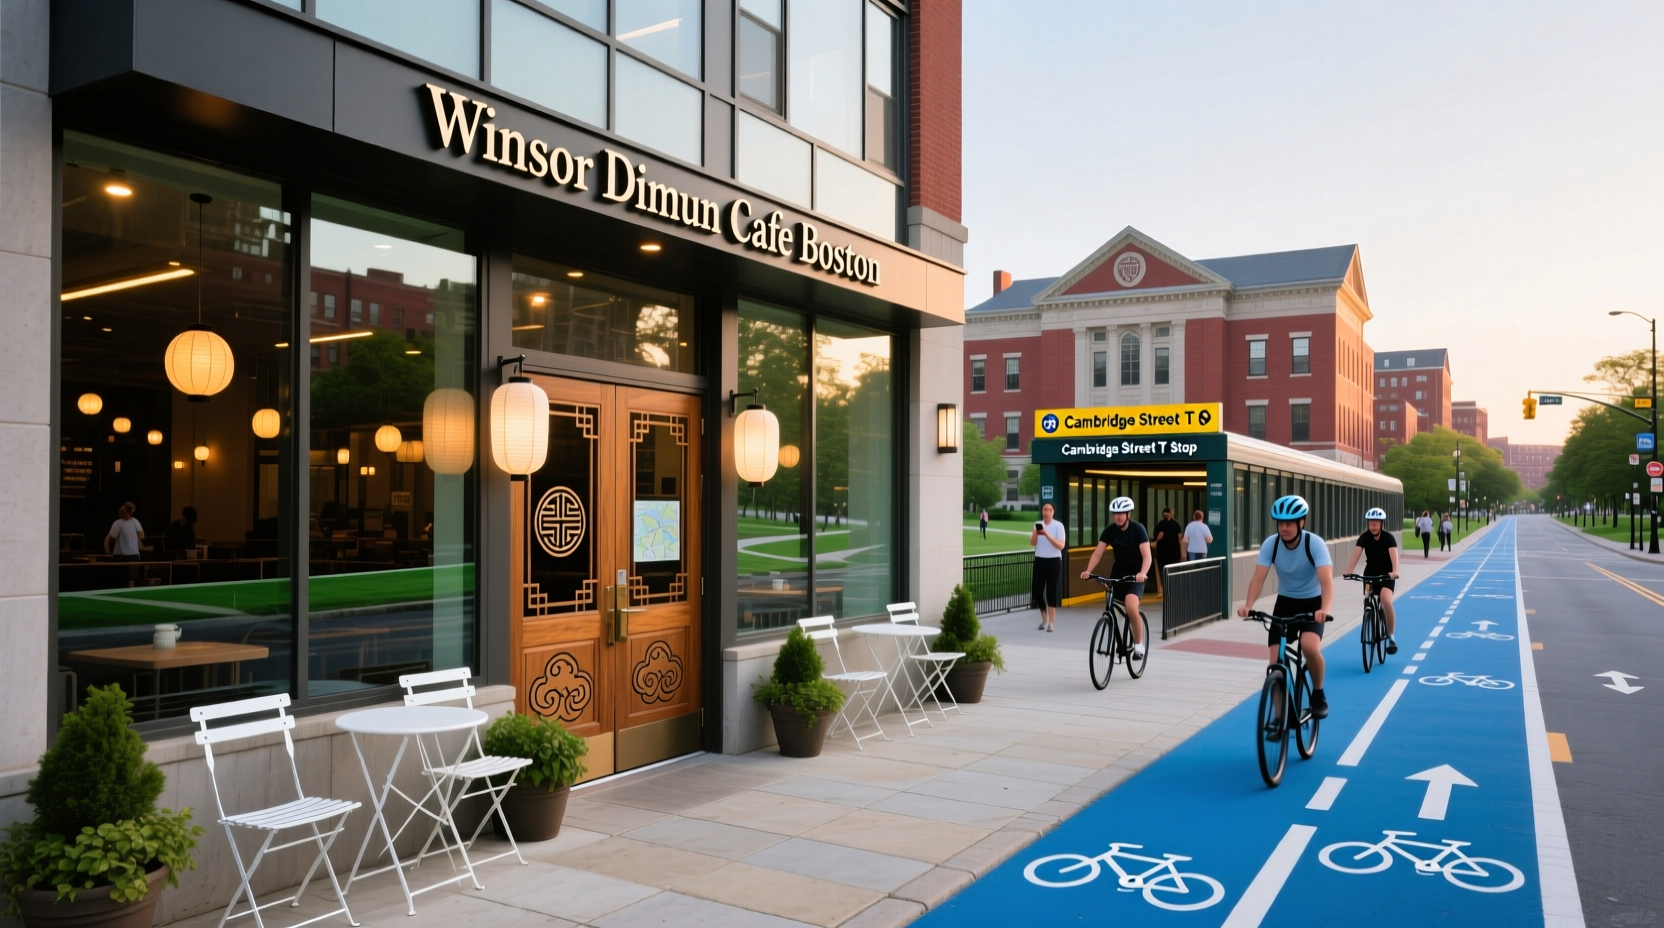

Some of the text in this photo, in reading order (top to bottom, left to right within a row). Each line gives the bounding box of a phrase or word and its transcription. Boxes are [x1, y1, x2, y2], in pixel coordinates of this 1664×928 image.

[425, 83, 880, 286] Winsor Dimun Cafe Boston
[1064, 413, 1135, 430] Cambridge
[1139, 412, 1180, 426] Street
[1184, 411, 1195, 425] T
[1061, 441, 1197, 458] Cambridge Street T Stop
